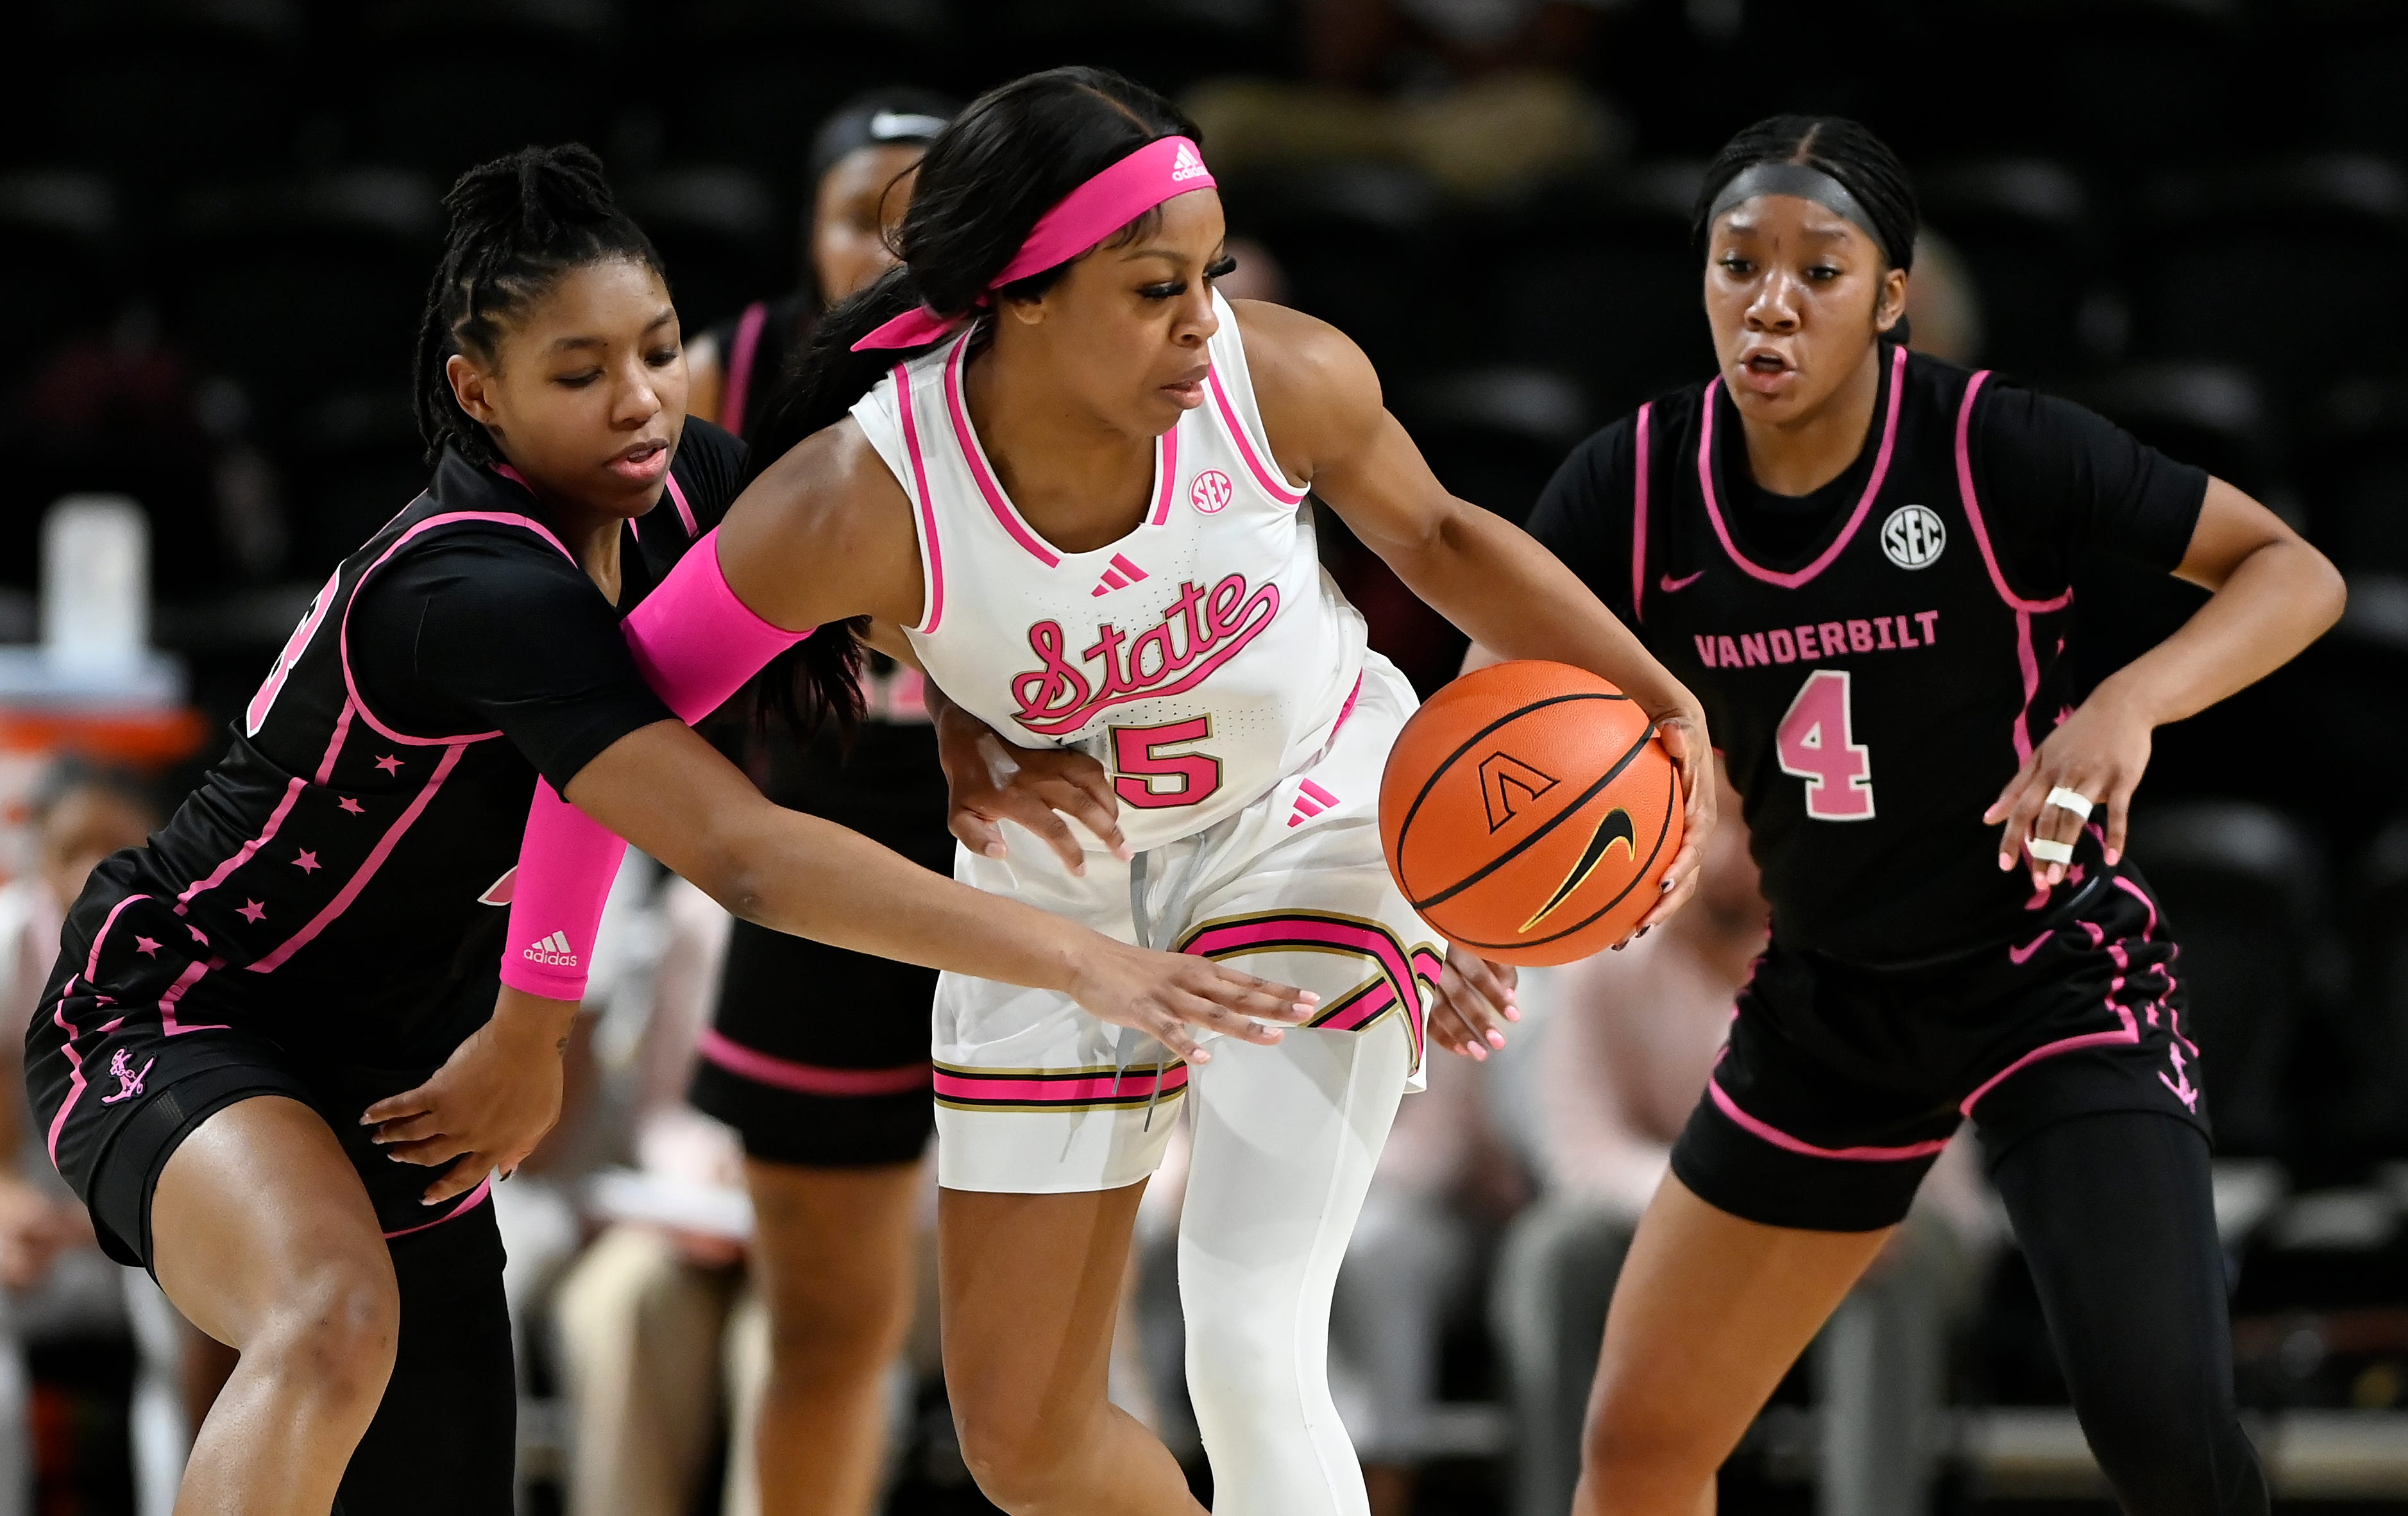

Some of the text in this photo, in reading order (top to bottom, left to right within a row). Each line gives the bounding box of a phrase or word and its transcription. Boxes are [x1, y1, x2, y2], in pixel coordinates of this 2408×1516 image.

[1171, 164, 1209, 181] adid
[1192, 471, 1232, 512] SEC
[1885, 507, 1942, 565] SEC
[1010, 573, 1280, 735] State
[1693, 610, 1939, 668] VANDERBILT
[1108, 712, 1223, 810] 5
[1777, 669, 1876, 821] 4
[523, 948, 578, 967] adidas
